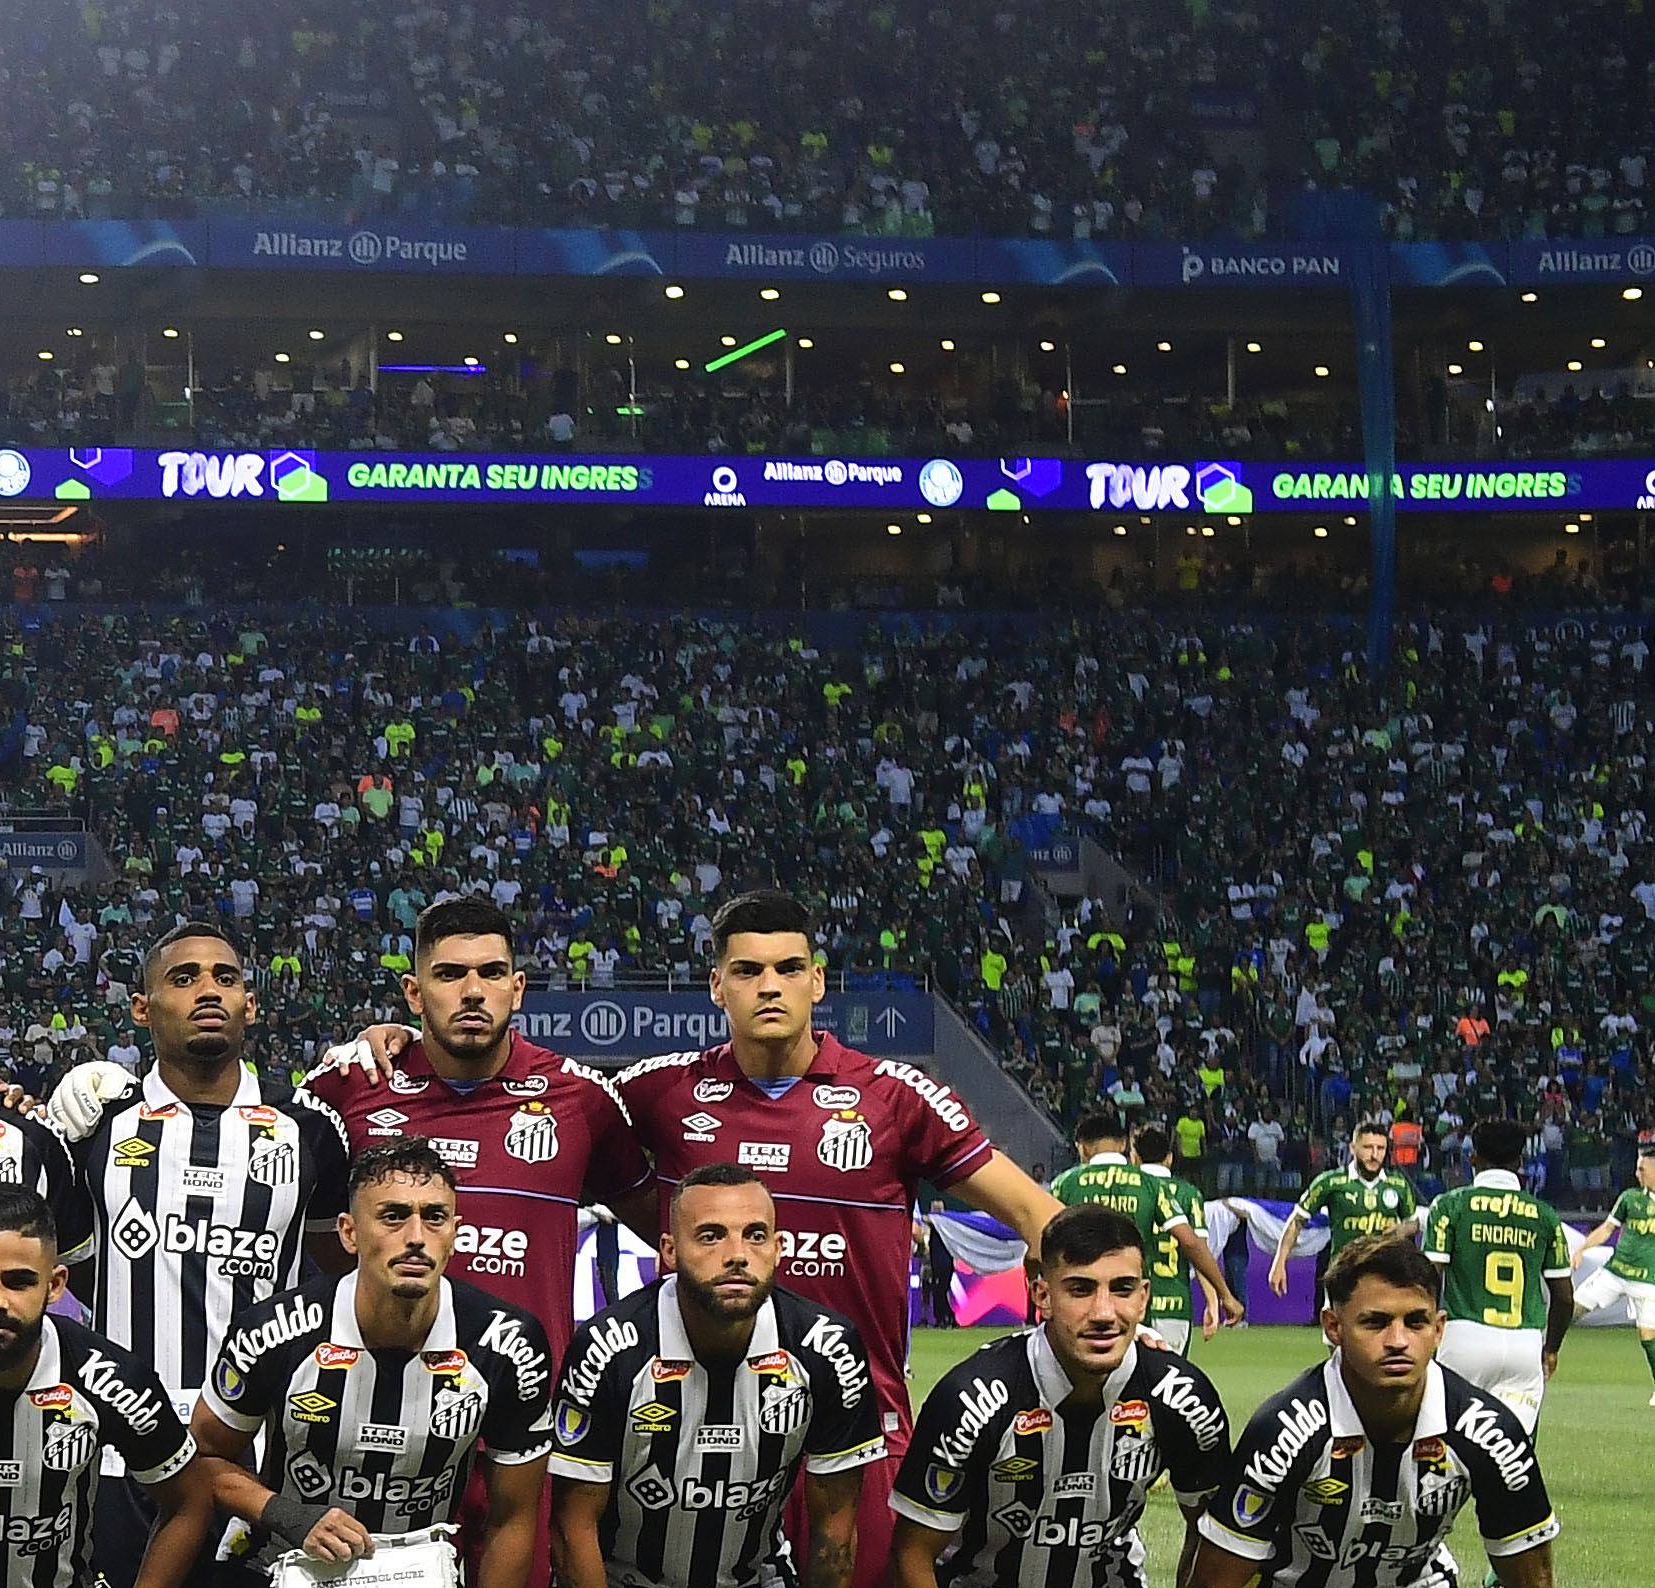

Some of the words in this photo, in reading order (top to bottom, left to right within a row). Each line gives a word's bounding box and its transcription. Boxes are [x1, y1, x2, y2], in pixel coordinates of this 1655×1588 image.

[254, 233, 342, 257] Allianz
[386, 238, 467, 266] Parque
[726, 244, 804, 267] Allianz
[843, 247, 925, 273] Seguros
[1539, 250, 1622, 272] Allianz
[1212, 258, 1285, 275] BANCO
[1293, 257, 1339, 275] PAN
[158, 452, 264, 497] TOUR
[348, 464, 481, 489] GARANTA
[485, 466, 539, 490] SEU
[764, 462, 822, 482] Allianz
[848, 465, 902, 486] Parque
[1086, 462, 1190, 510] TOUR
[1273, 473, 1404, 498] GARANA
[1410, 473, 1461, 498] SEU
[2, 842, 54, 857] Allianz
[632, 1004, 731, 1046] Parqu
[874, 1060, 969, 1133] Kicaldo
[115, 1157, 149, 1167] umbro
[183, 1179, 223, 1189] BOND
[1470, 1193, 1540, 1219] crefisa
[166, 1214, 278, 1261] blaze
[1472, 1223, 1537, 1249] ENDRICK
[218, 1259, 274, 1280] .com
[467, 1256, 526, 1278] .com
[786, 1260, 844, 1278] .com
[1484, 1251, 1525, 1329] 9
[226, 1295, 324, 1374] Kicaldo
[561, 1316, 640, 1407] Kicaldo
[801, 1313, 869, 1411] Kicaldo
[76, 1348, 160, 1436] Kicaldo
[292, 1411, 331, 1424] umbro
[634, 1421, 671, 1433] umbro
[932, 1377, 1009, 1469] Kicaldo
[360, 1436, 404, 1447] BOND
[361, 1427, 405, 1439] TEK
[697, 1427, 741, 1438] TEK
[697, 1436, 741, 1446] BOND
[1244, 1398, 1328, 1493] Kicaldo
[1456, 1397, 1534, 1492] Kicaldo
[342, 1465, 454, 1504] blaze
[685, 1468, 787, 1510] blaze
[349, 1573, 392, 1587] FUTEBOL
[392, 1569, 425, 1581] CLUBE
